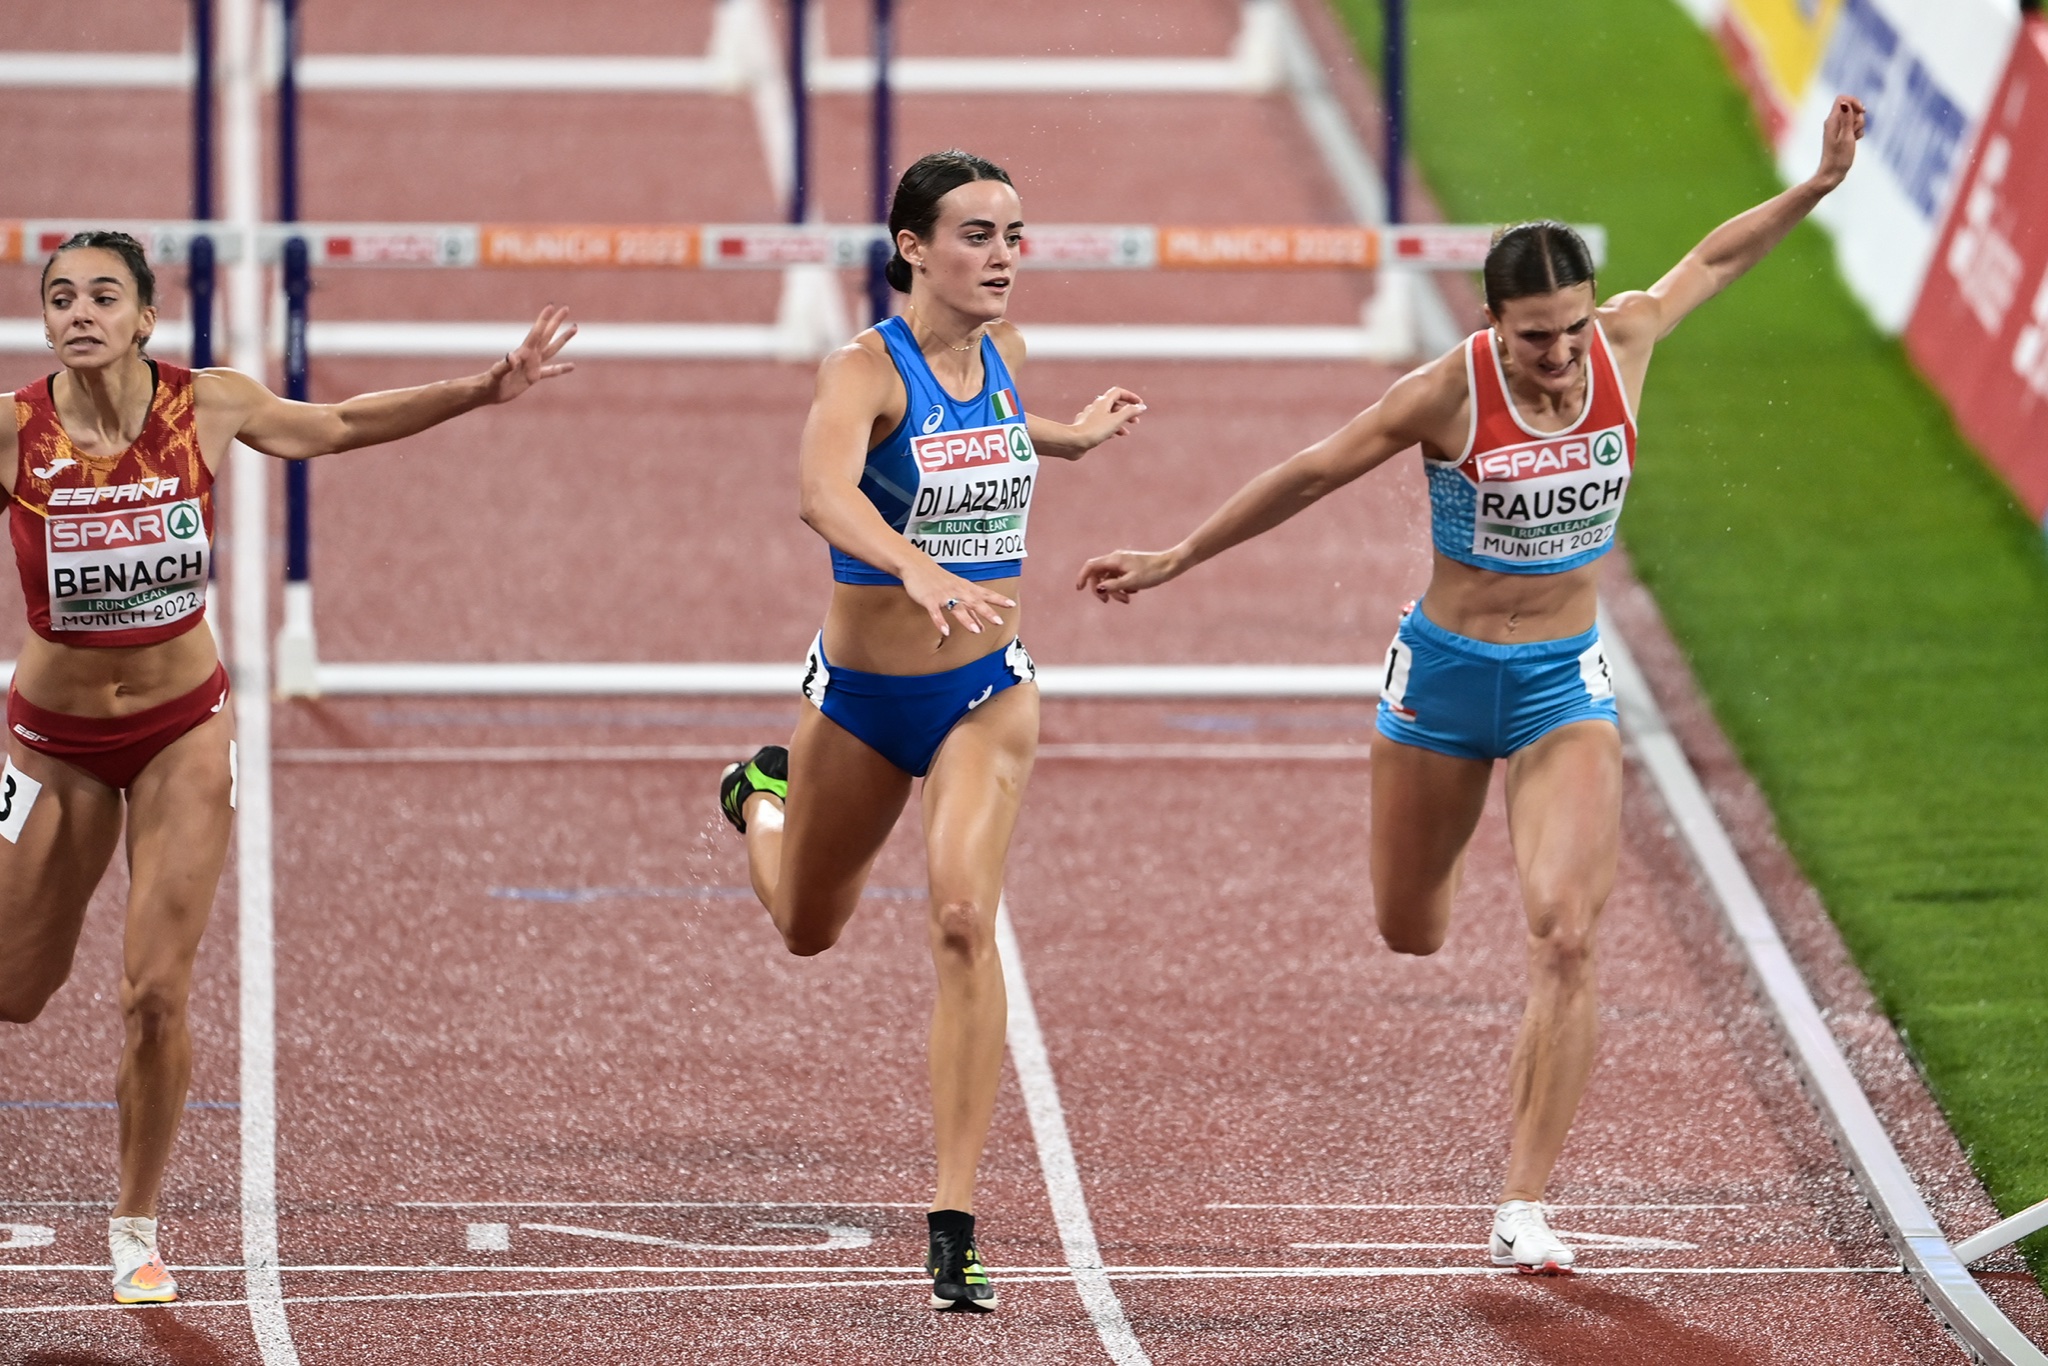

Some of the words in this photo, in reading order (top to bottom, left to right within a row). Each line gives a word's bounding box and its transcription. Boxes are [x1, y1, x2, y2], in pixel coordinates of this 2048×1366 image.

[920, 433, 1008, 468] SPAR
[1483, 442, 1589, 479] SPAR
[915, 486, 943, 517] DI
[944, 475, 1032, 515] LAZZARO
[1481, 476, 1625, 521] RAUSCH
[52, 514, 164, 548] SPAR
[944, 520, 973, 533] RUN
[1518, 524, 1547, 538] RUN
[995, 534, 1024, 555] 202
[1483, 536, 1564, 557] MUNICH
[54, 550, 203, 598] BENACH
[95, 598, 125, 611] RUN
[153, 591, 198, 621] 2022
